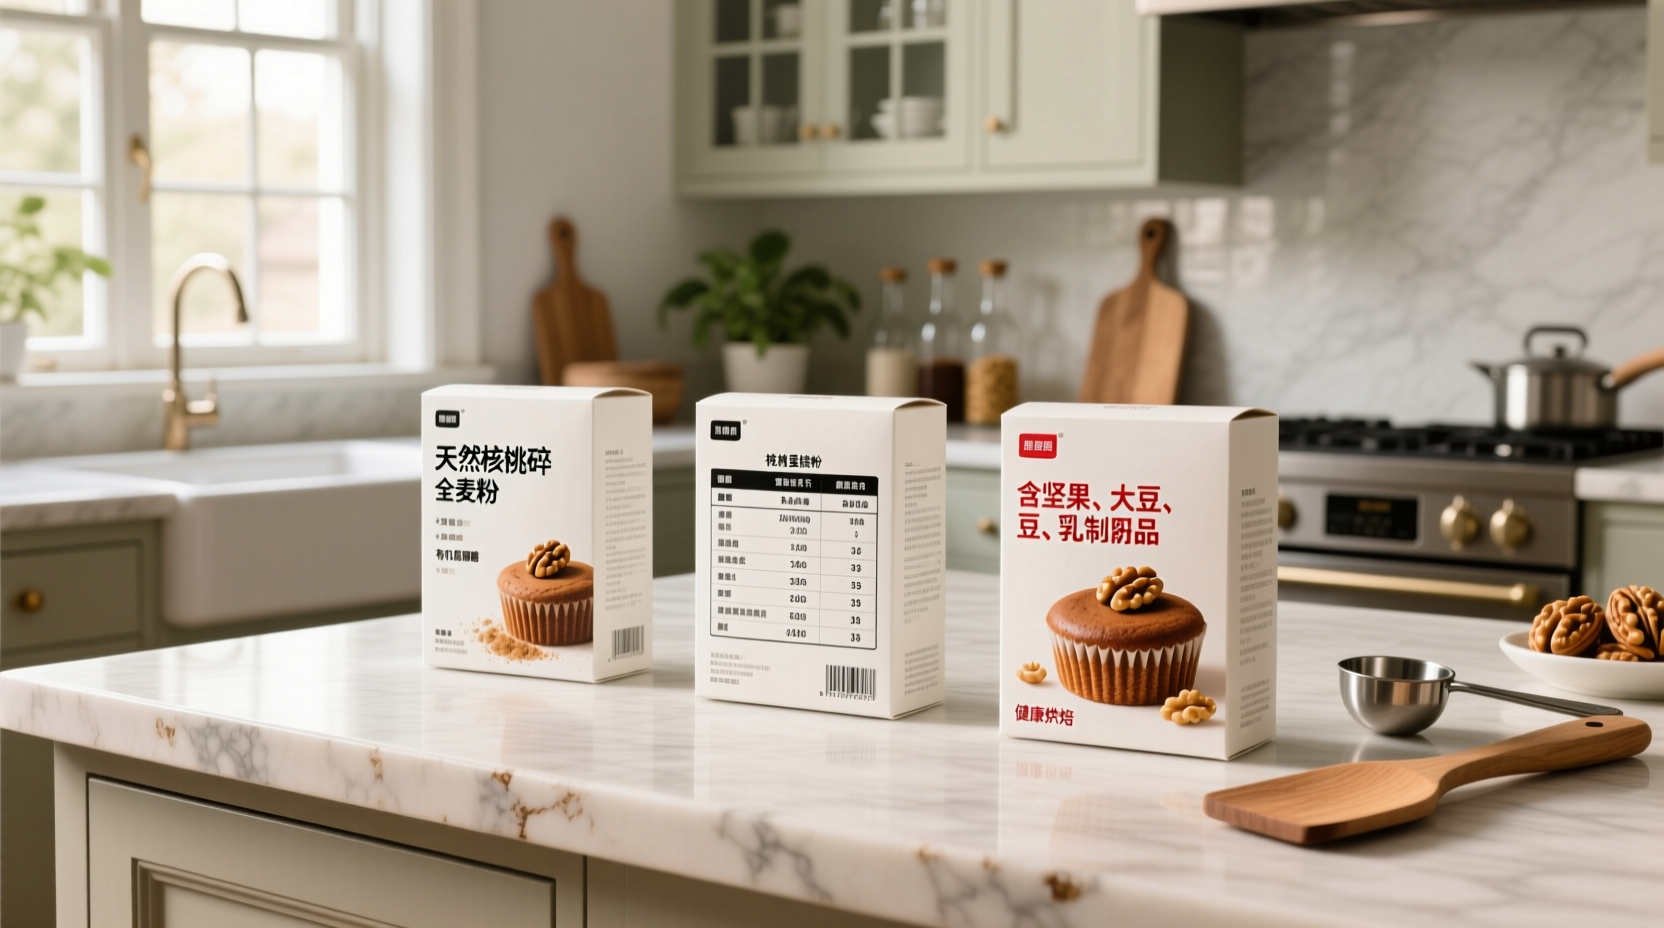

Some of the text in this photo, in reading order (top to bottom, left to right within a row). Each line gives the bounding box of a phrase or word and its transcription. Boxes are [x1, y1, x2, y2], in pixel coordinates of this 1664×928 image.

[435, 477, 499, 505] 全麦粉
[1017, 480, 1172, 514] 含坚果、大豆、
[1015, 703, 1075, 726] 健康烘焙
